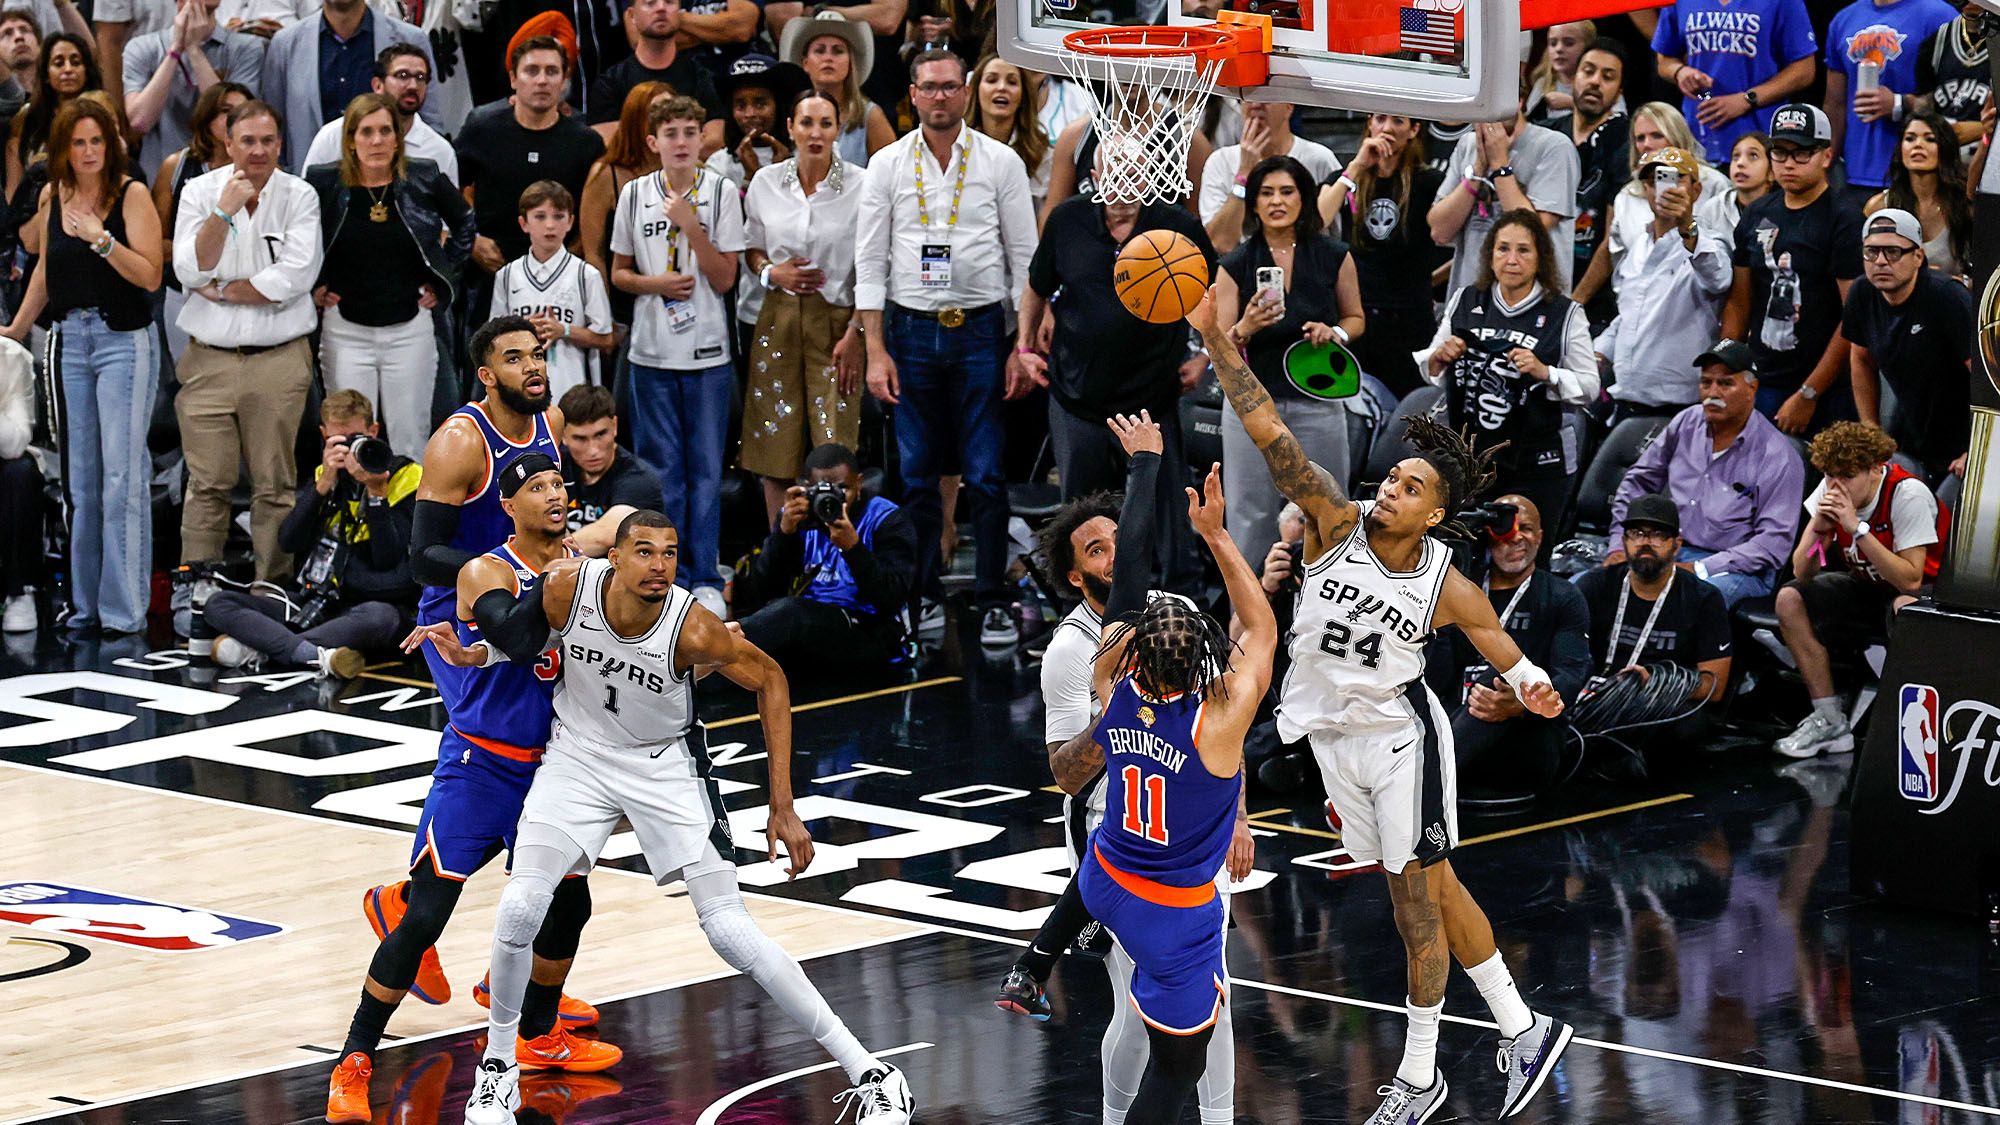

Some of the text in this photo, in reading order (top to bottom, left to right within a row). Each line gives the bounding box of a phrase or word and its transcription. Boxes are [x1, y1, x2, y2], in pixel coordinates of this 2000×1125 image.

[1685, 11, 1760, 33] ALWAYS
[1685, 31, 1757, 57] KNICKS
[1933, 78, 1990, 108] SPUR
[1320, 578, 1418, 642] SPURS
[1319, 619, 1385, 671] 24
[534, 647, 561, 681] 3
[570, 634, 664, 694] SPURS
[603, 683, 621, 716] 1
[1106, 728, 1188, 774] BRUNSON
[1904, 773, 1924, 793] NBA
[1121, 763, 1169, 847] 11
